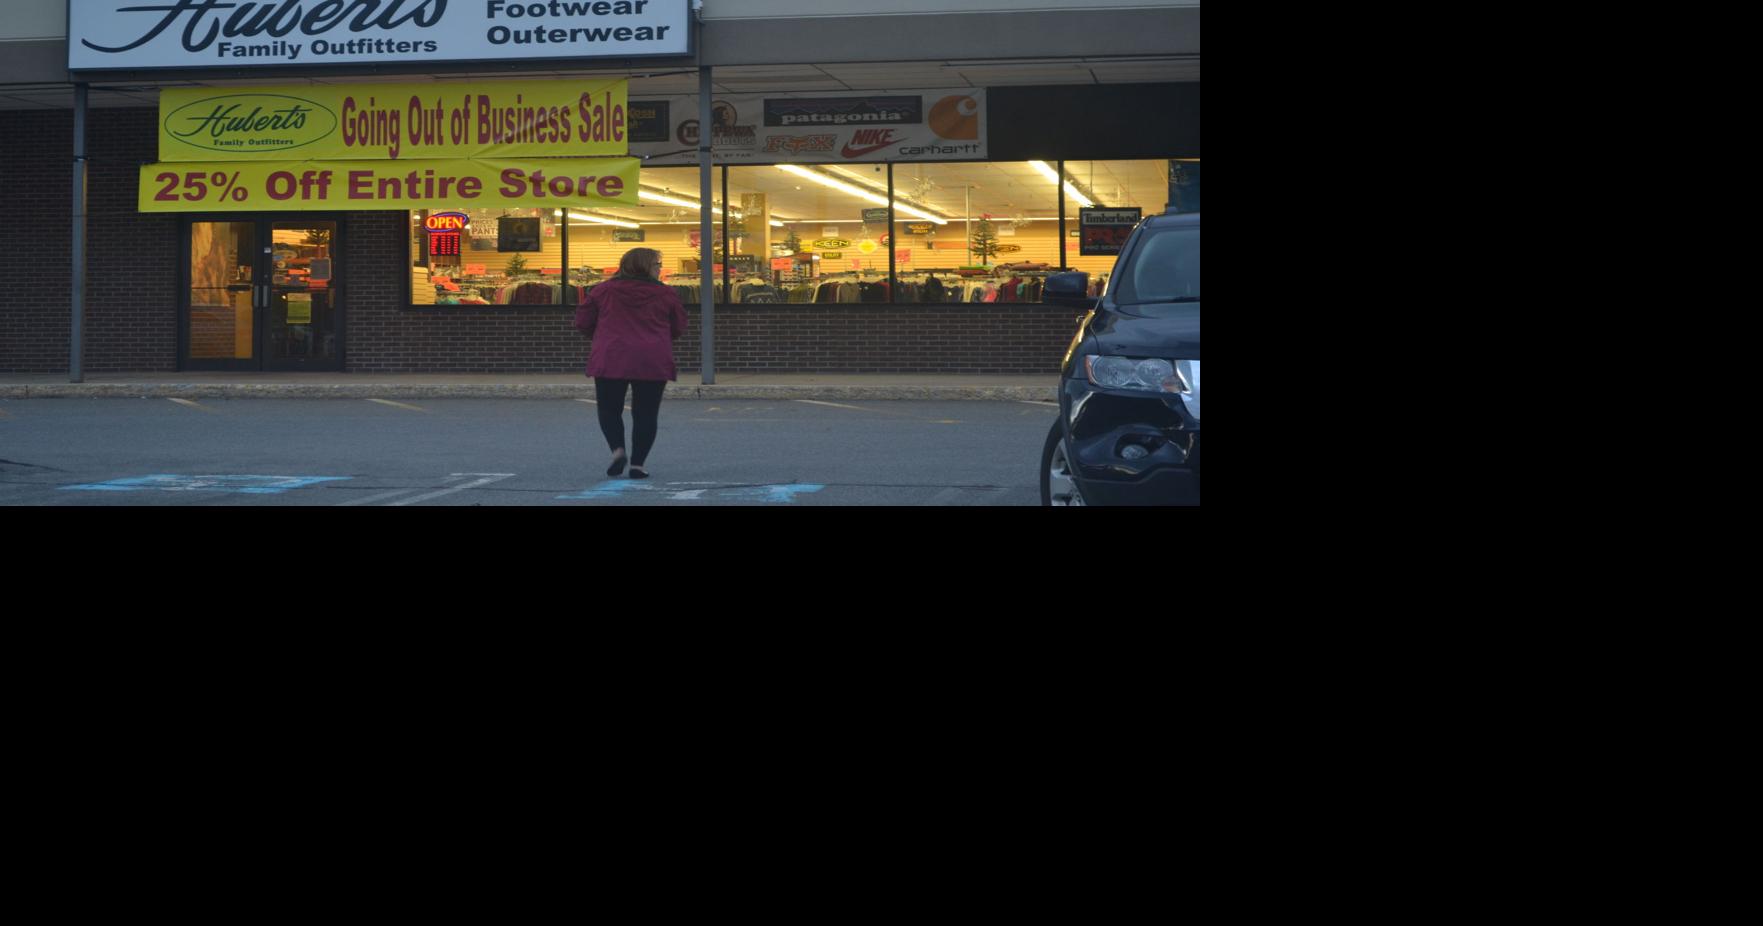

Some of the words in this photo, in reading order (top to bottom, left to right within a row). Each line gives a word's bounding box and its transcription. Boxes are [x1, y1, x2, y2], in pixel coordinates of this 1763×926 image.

[487, 0, 649, 18] Footwear
[486, 25, 670, 45] Outerwear
[217, 41, 302, 60] Family
[310, 38, 438, 55] Outfitters
[173, 103, 313, 138] Hubert's
[341, 96, 400, 160] Going
[407, 95, 444, 147] Out
[450, 94, 471, 145] of
[477, 93, 572, 145] Business
[578, 91, 625, 143] Sale
[781, 110, 902, 125] patagonia
[213, 139, 244, 147] Family
[850, 129, 896, 145] NIKE
[899, 142, 979, 156] carhartt
[154, 171, 249, 202] 25%
[265, 170, 333, 200] Off
[348, 170, 483, 200] Entire
[499, 168, 625, 198] Store
[426, 216, 464, 229] OPEN
[1084, 213, 1139, 223] Timberland
